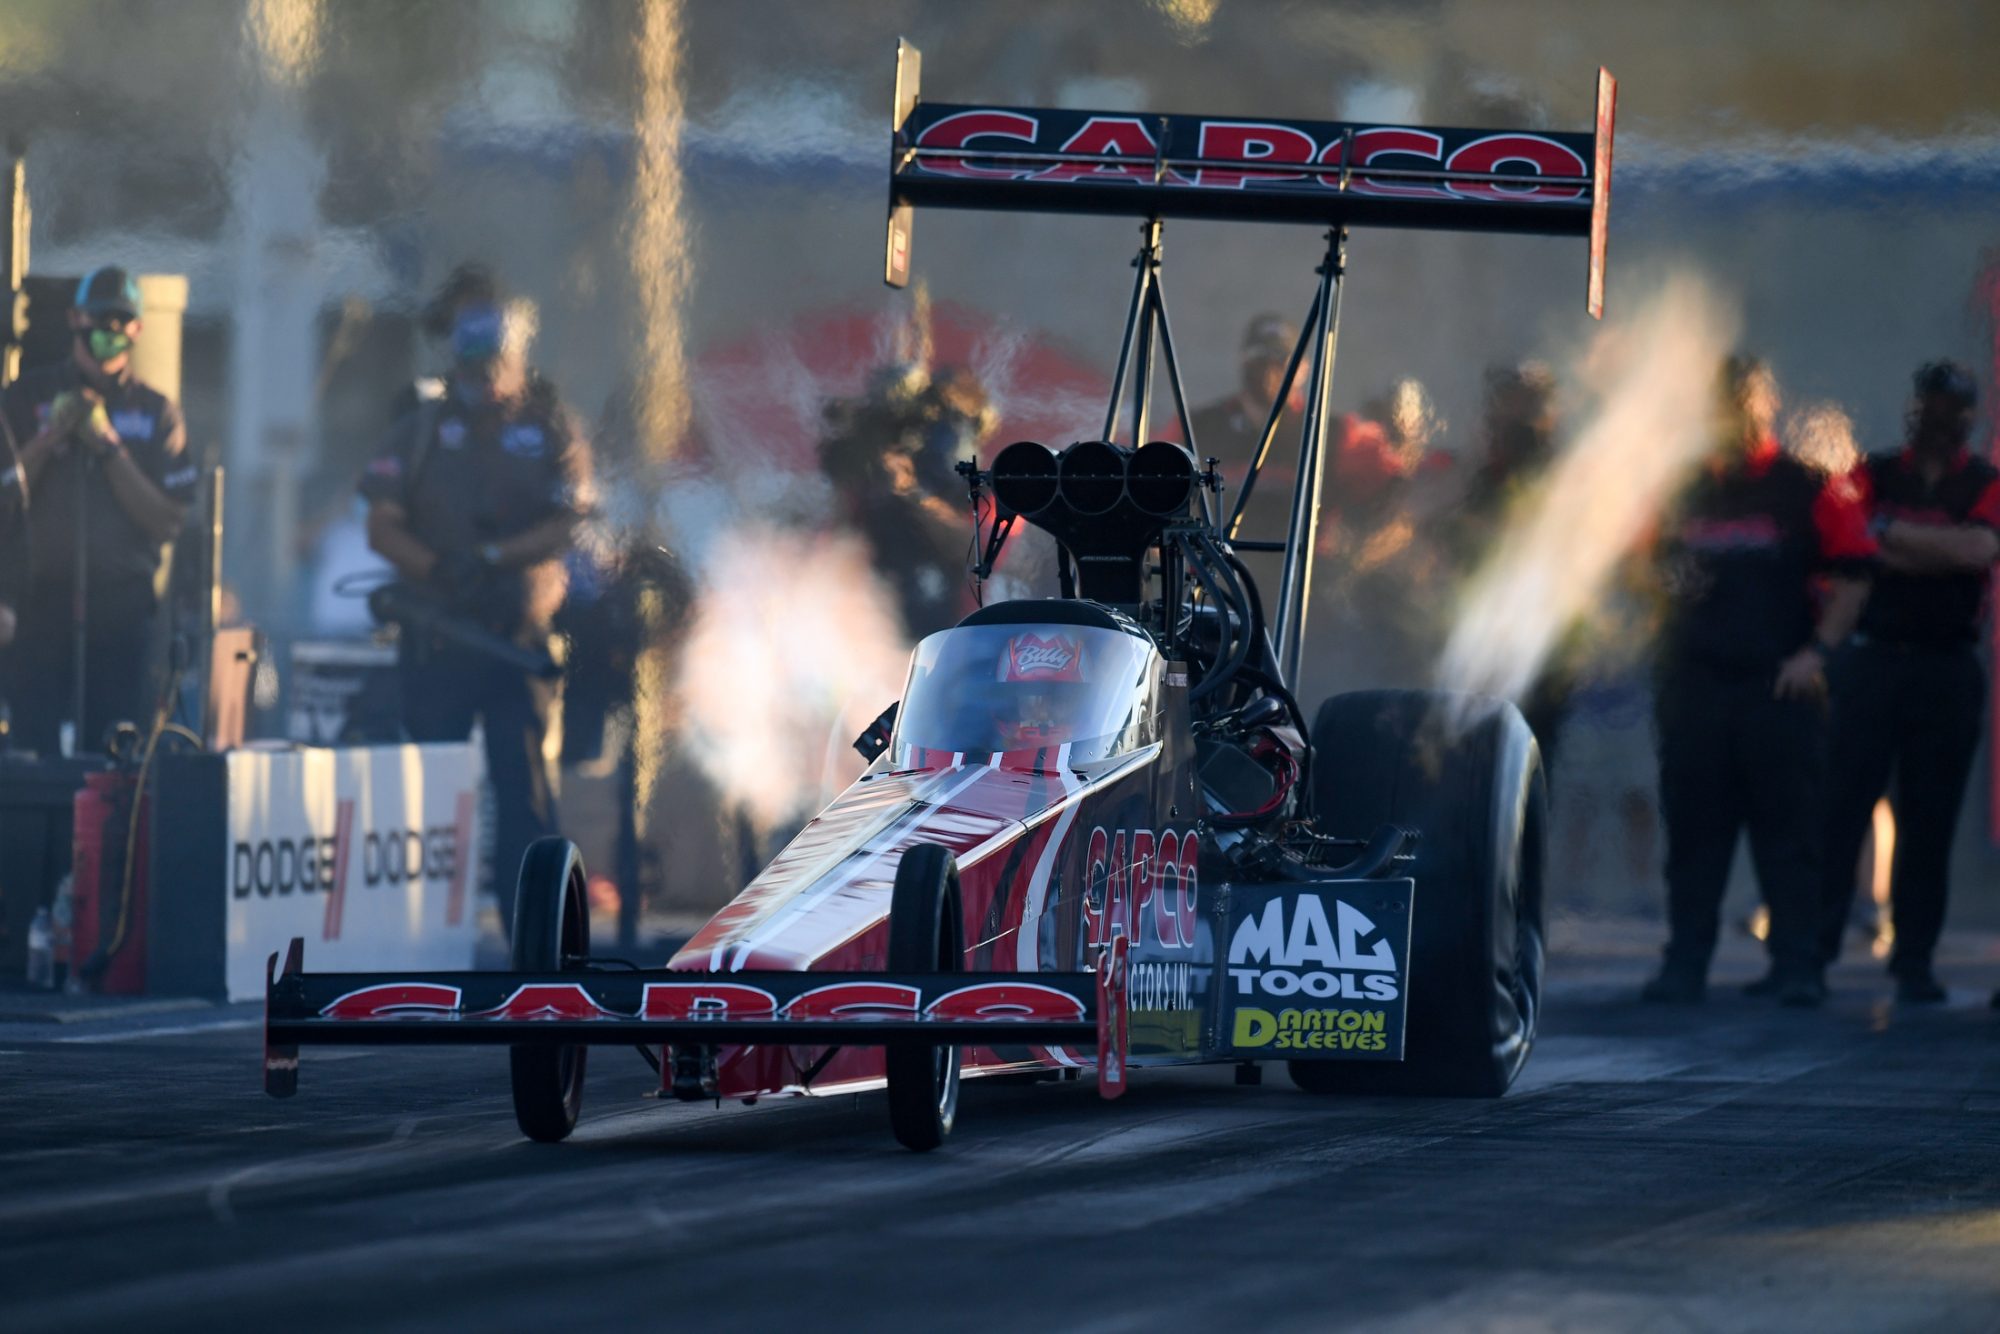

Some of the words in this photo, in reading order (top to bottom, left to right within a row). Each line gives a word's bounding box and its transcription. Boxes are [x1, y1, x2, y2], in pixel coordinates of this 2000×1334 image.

[915, 110, 1587, 200] CAPCO
[233, 835, 336, 899] DODGE
[363, 827, 459, 888] DODGE
[1084, 825, 1198, 949] CAPCO
[1228, 893, 1397, 972] MAC
[1228, 968, 1399, 1001] TOOLS
[1231, 1007, 1387, 1048] DARTON
[1275, 1030, 1387, 1050] SLEEVES
